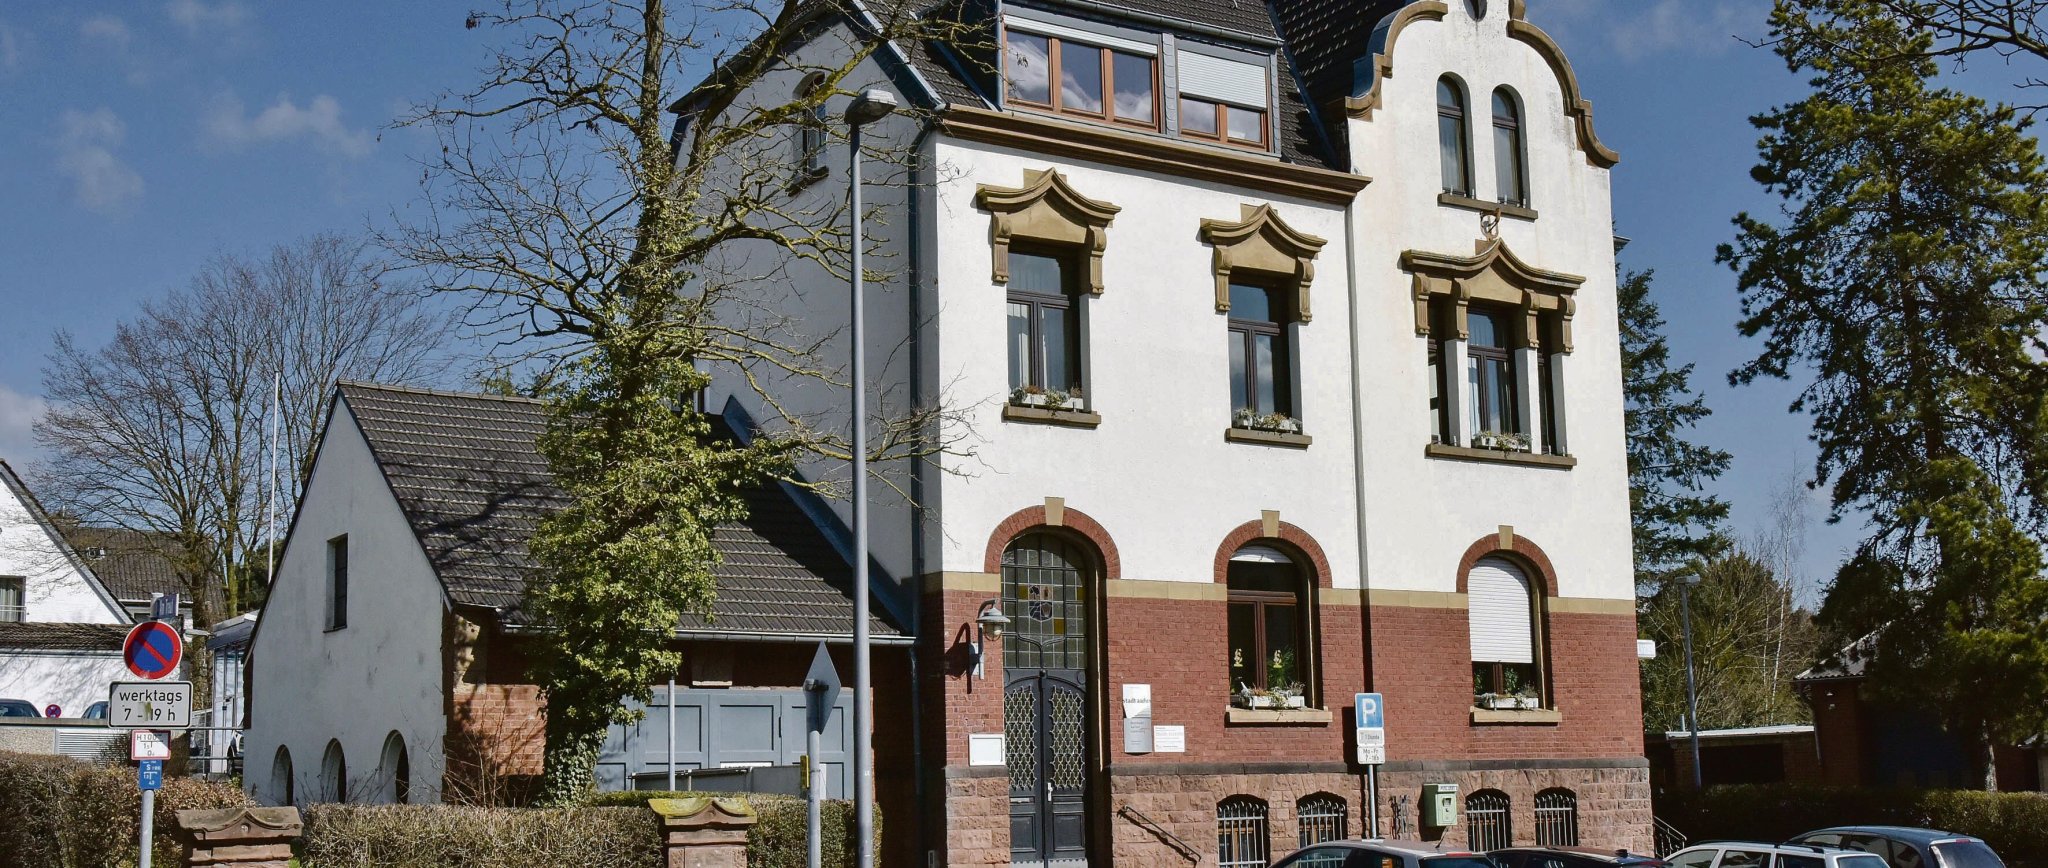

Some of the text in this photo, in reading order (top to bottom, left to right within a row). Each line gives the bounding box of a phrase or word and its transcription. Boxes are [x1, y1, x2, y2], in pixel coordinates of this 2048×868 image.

[119, 689, 182, 705] werktags
[124, 708, 132, 721] 7
[149, 708, 162, 721] 19
[167, 708, 176, 721] h
[1362, 698, 1376, 724] P
